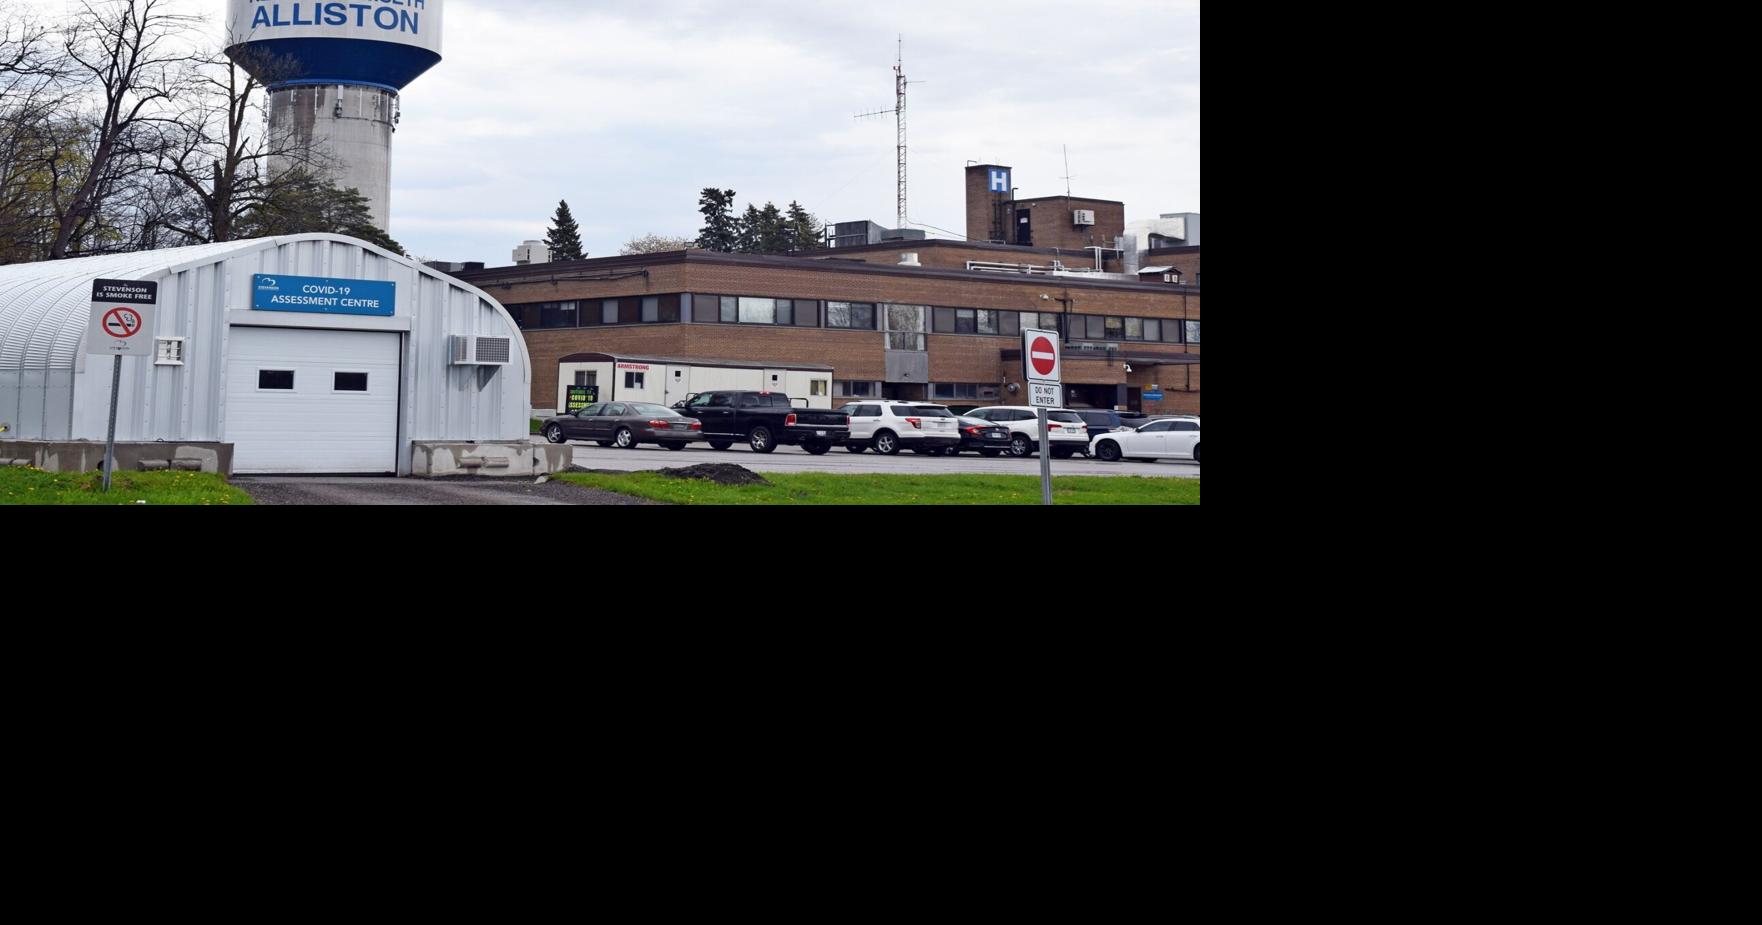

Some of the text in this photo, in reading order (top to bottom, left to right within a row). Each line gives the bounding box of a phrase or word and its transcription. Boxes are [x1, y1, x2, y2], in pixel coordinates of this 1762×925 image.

[251, 2, 419, 34] ALLISTON
[991, 171, 1007, 192] H
[302, 284, 351, 295] COVID-19
[271, 295, 380, 308] ASSESSMENT CENTRE
[617, 363, 650, 371] ARMSTRONG
[1035, 386, 1054, 395] DO NOT
[1036, 396, 1055, 405] ENTER
